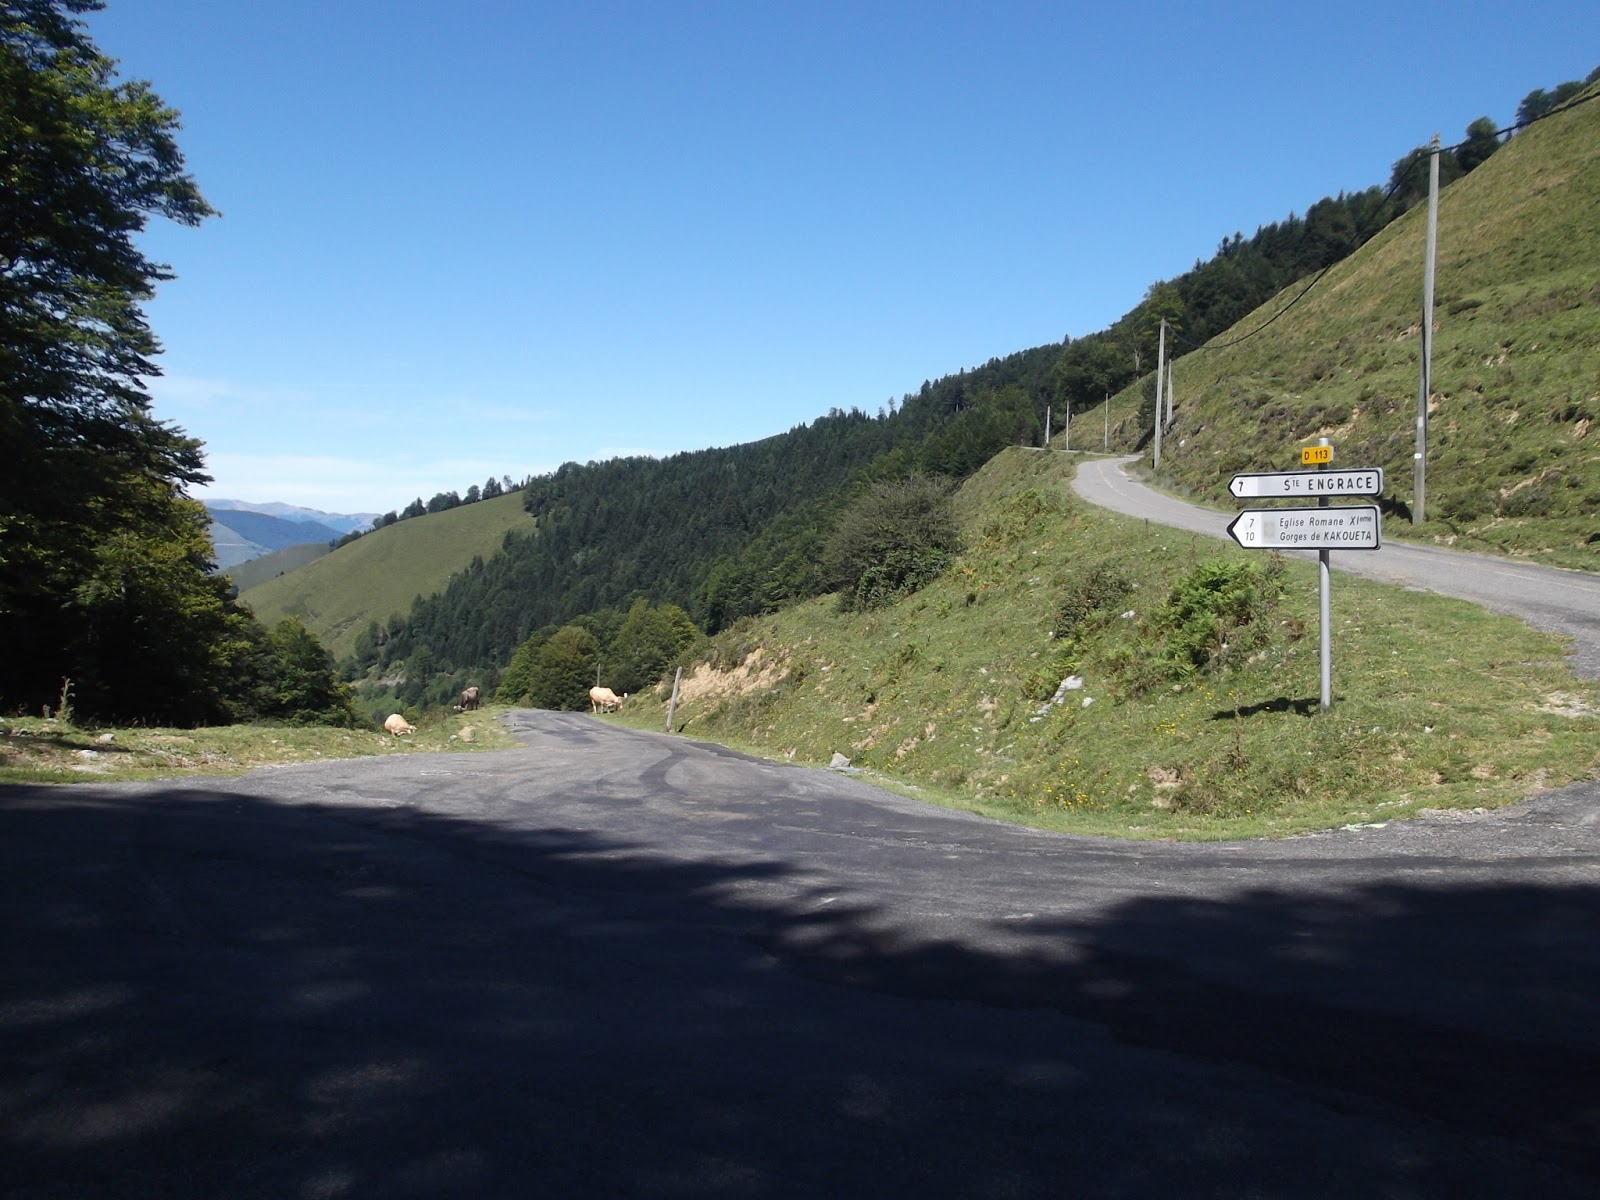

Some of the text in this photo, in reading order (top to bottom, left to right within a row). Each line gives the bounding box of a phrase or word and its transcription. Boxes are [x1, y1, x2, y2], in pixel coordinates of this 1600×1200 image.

[1304, 449, 1328, 461] D 113
[1238, 481, 1244, 492] 7
[1308, 476, 1373, 490] ENGRACE
[1249, 518, 1255, 528] 7
[1279, 517, 1305, 529] Eglise
[1309, 516, 1344, 527] Romane
[1245, 531, 1255, 541] 10
[1279, 530, 1372, 543] Gorges de KAKOUETA
